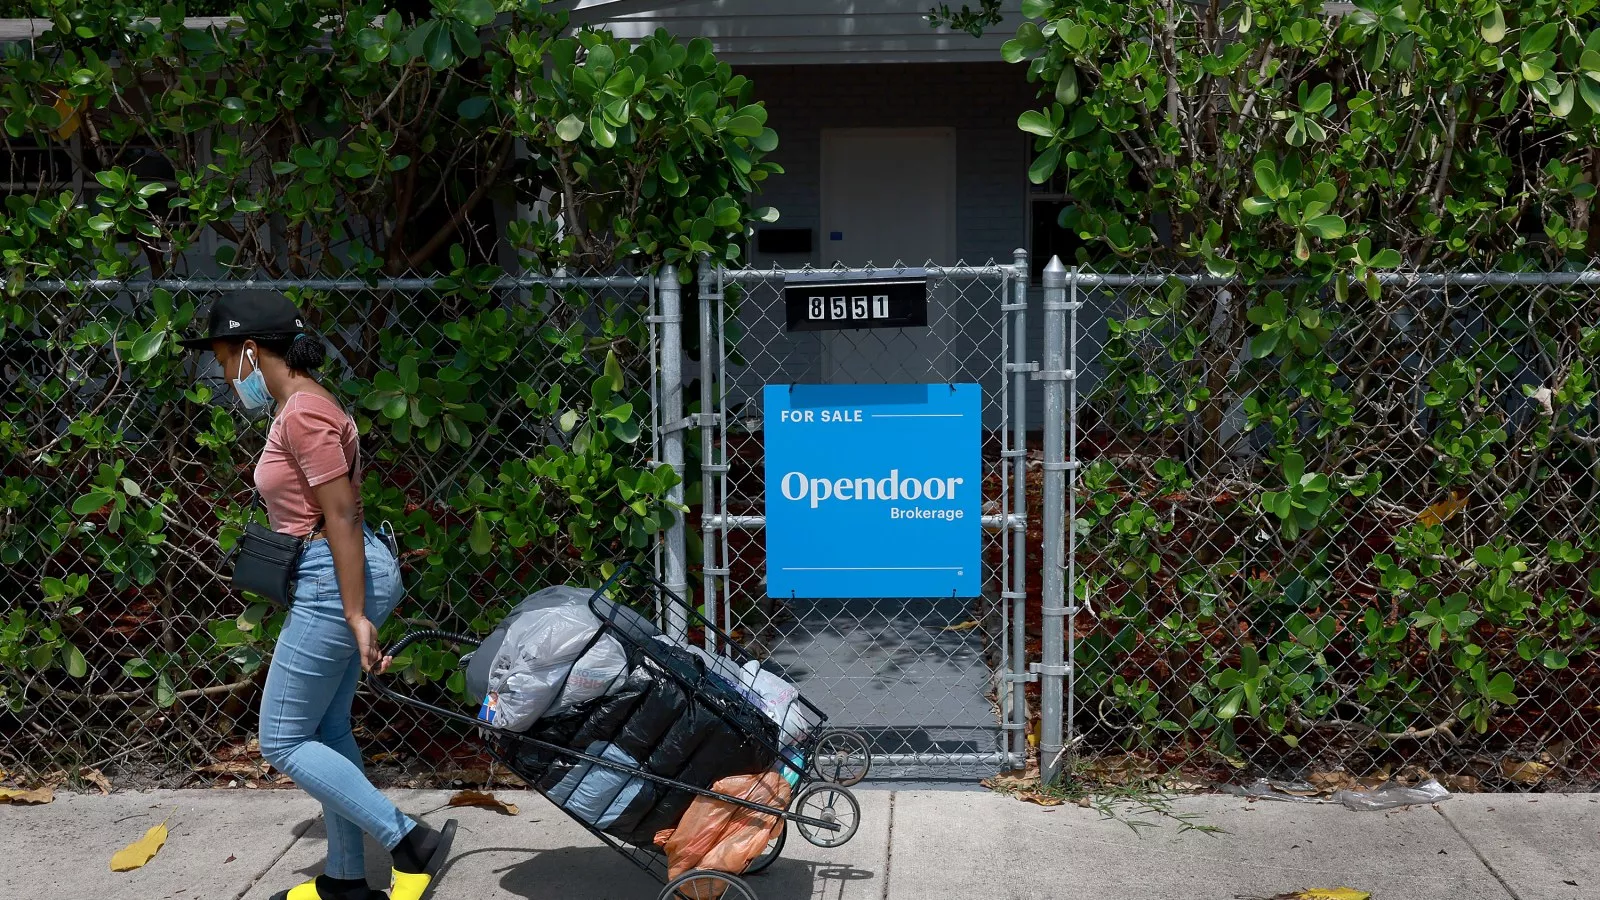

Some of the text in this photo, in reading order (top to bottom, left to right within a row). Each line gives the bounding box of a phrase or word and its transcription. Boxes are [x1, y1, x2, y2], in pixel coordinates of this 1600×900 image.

[810, 296, 886, 319] 8551
[781, 410, 863, 423] FOR SALE
[781, 469, 964, 509] Opendoor
[890, 507, 964, 521] Brokerage
